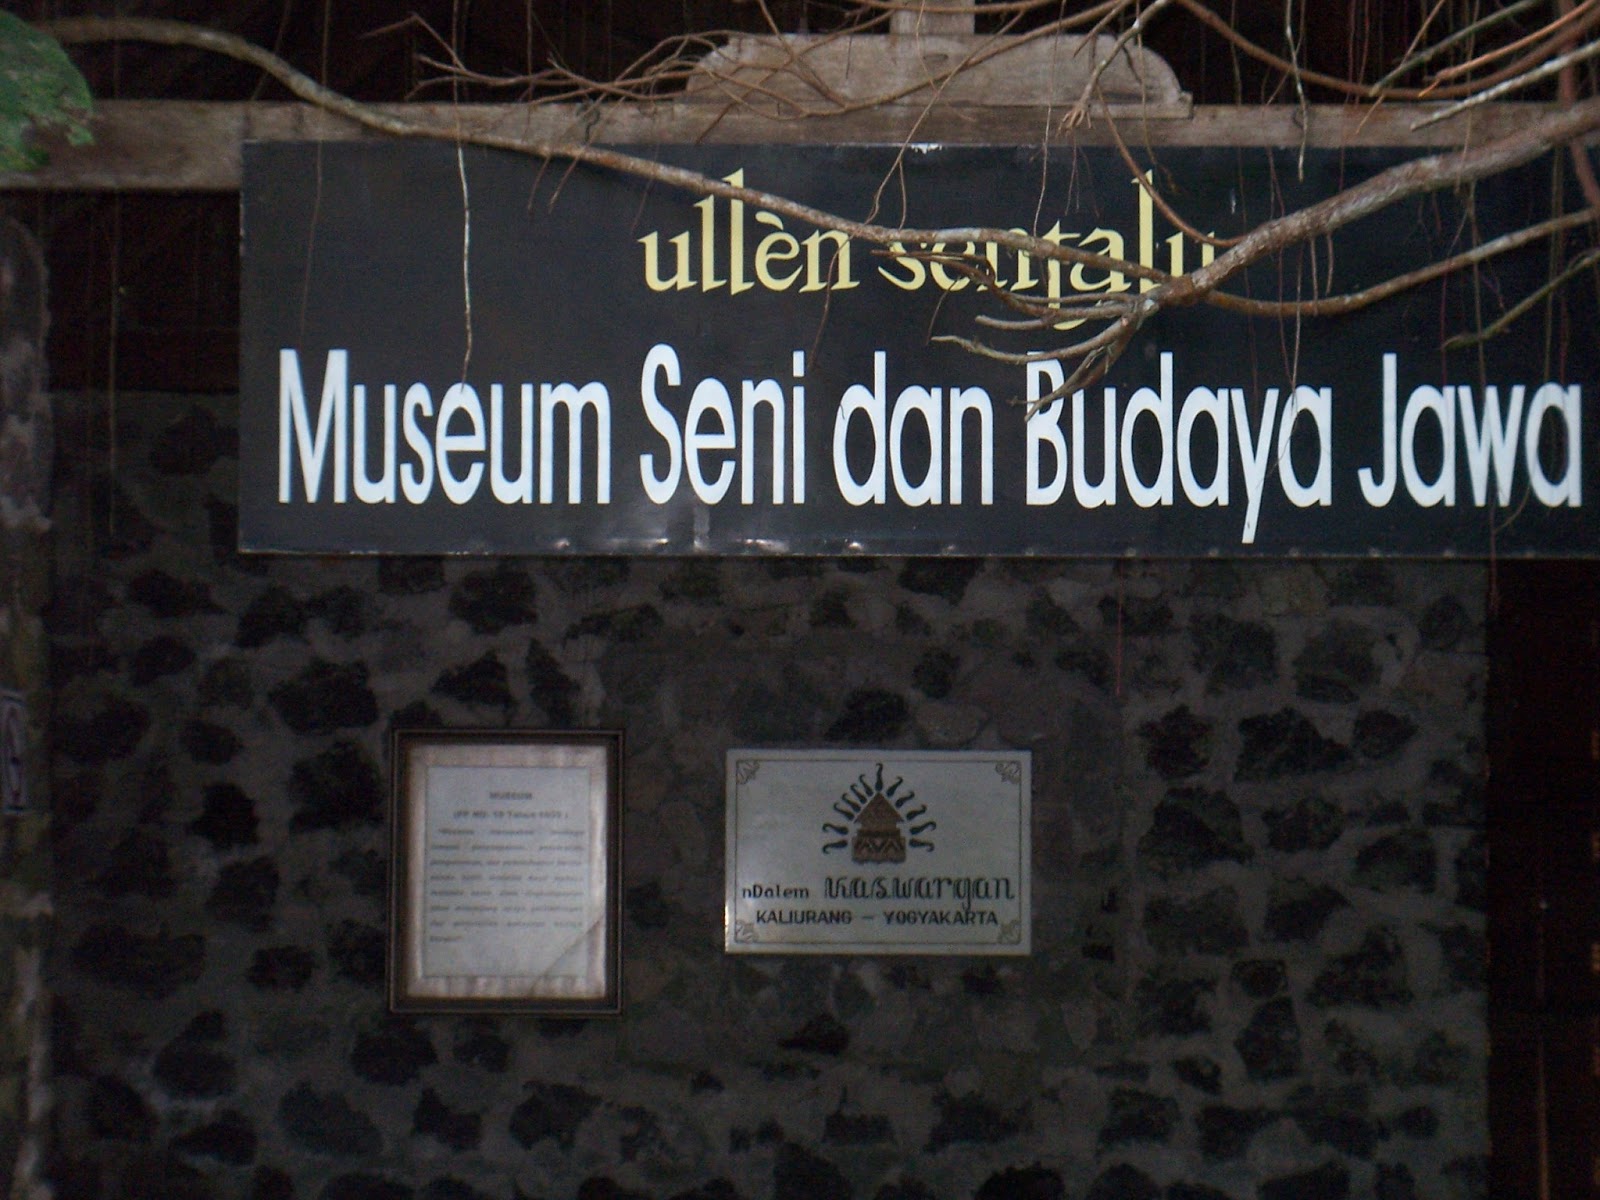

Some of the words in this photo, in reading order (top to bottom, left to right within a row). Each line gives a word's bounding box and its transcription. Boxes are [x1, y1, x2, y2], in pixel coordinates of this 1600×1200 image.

[278, 348, 611, 505] Museum
[639, 343, 806, 505] Seni
[832, 350, 994, 507] dan
[1025, 350, 1332, 544] Budaya
[1357, 352, 1582, 508] Jawa
[742, 884, 810, 899] nDalem
[756, 910, 853, 925] KALIURANG
[883, 910, 999, 925] YOGYAKARTA
